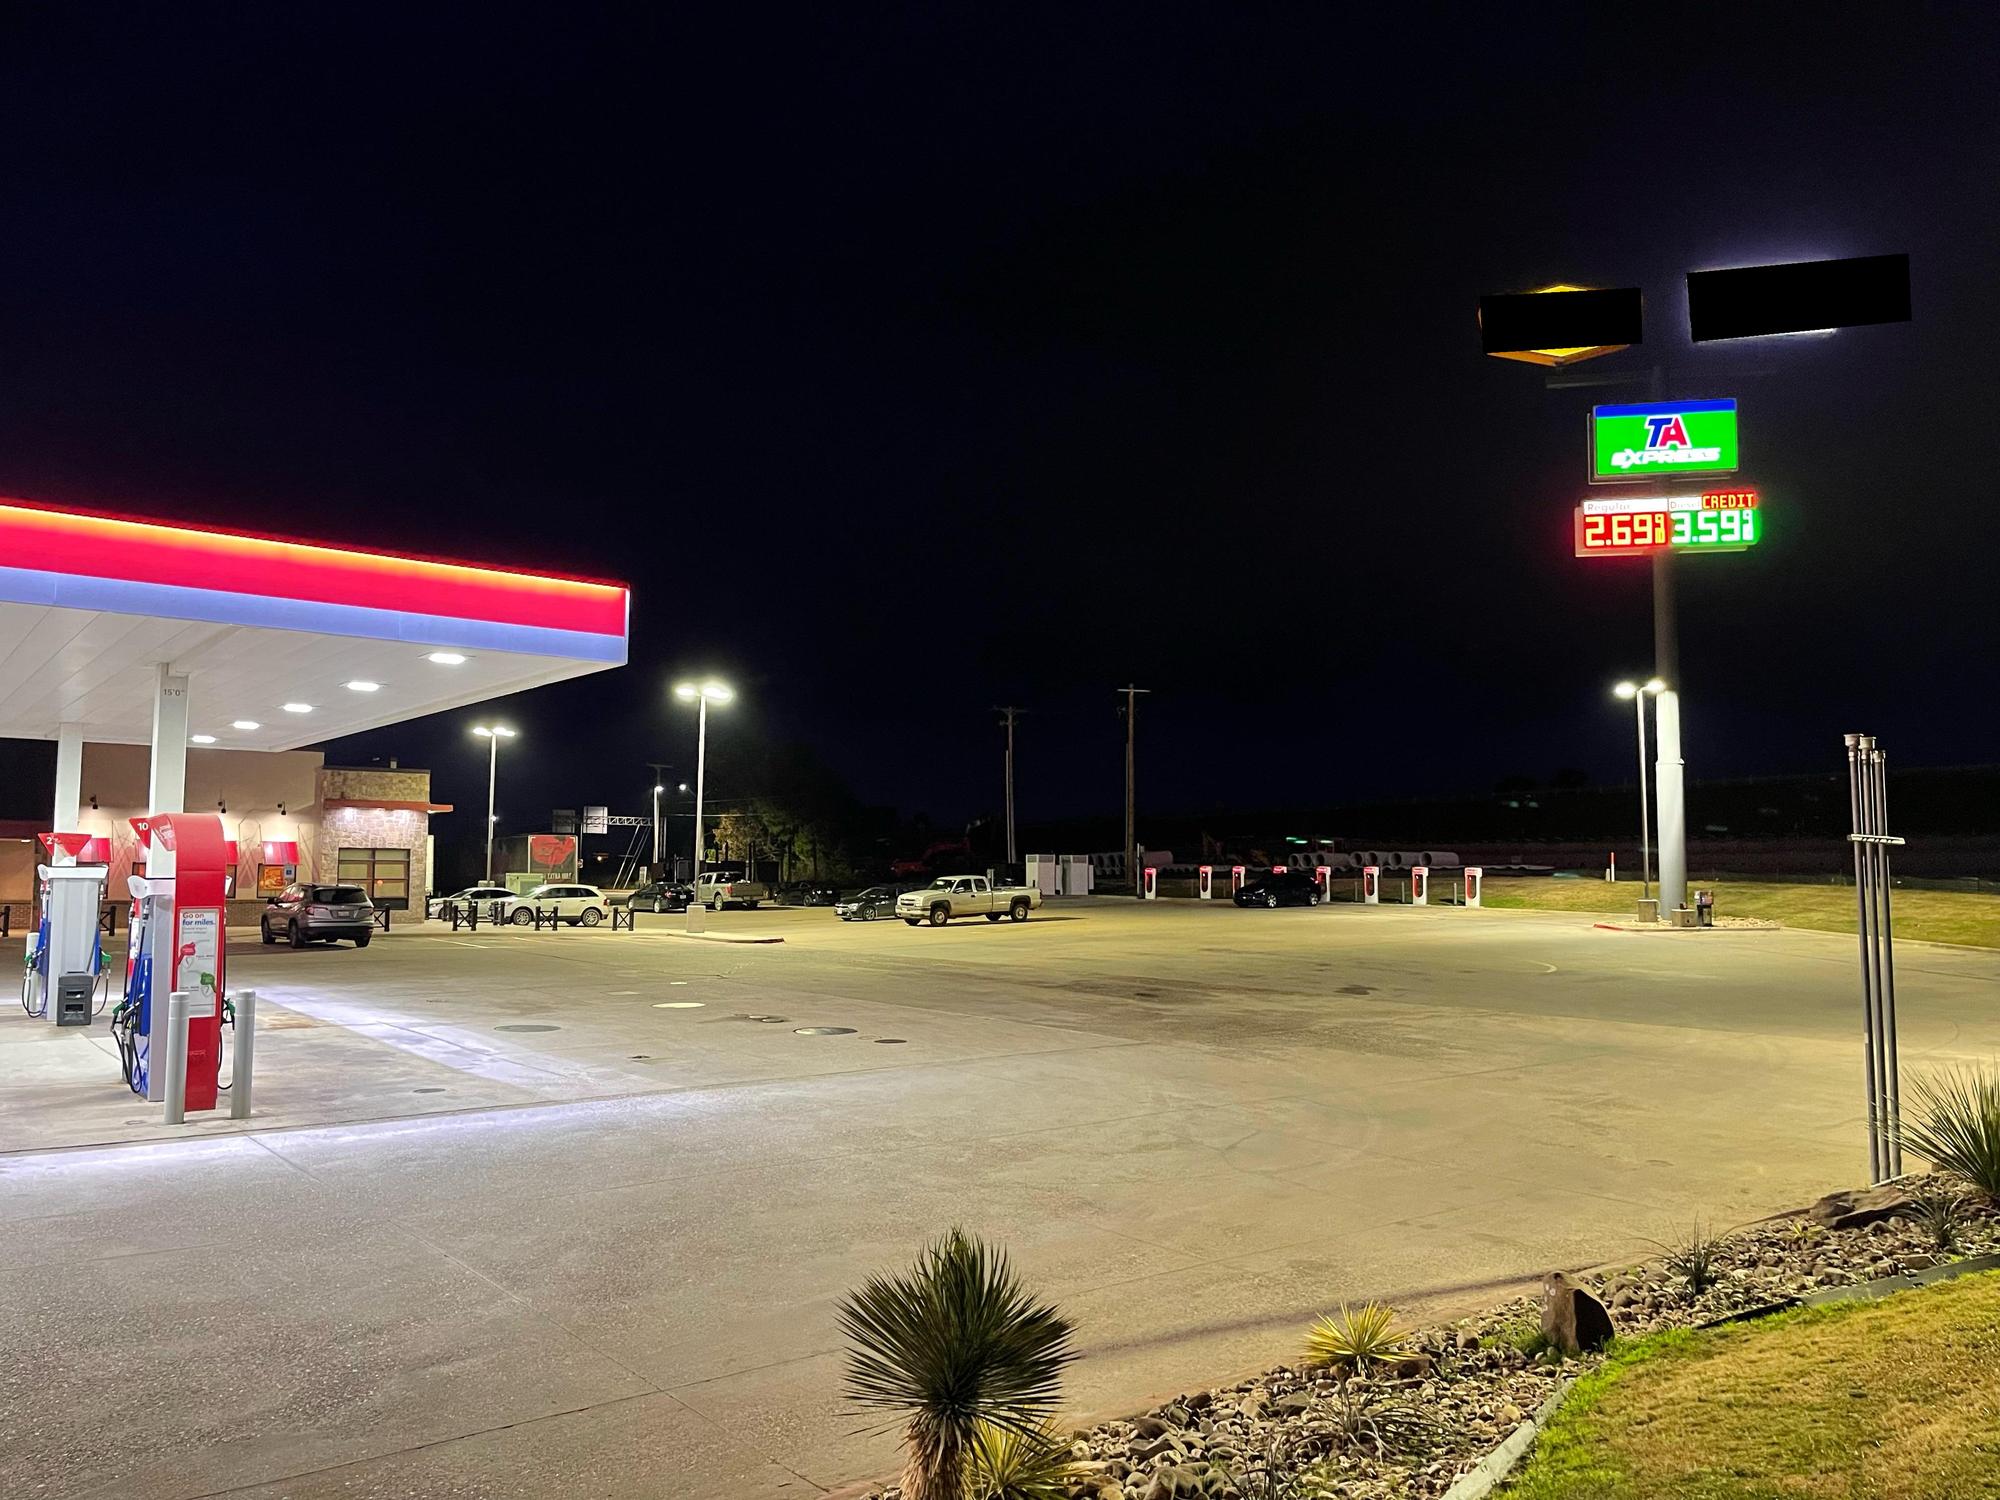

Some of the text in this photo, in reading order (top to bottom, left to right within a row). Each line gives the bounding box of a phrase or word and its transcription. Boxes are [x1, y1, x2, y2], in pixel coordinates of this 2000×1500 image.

[1645, 414, 1691, 449] TA
[1702, 493, 1754, 510] CREDIT
[137, 822, 149, 831] 10
